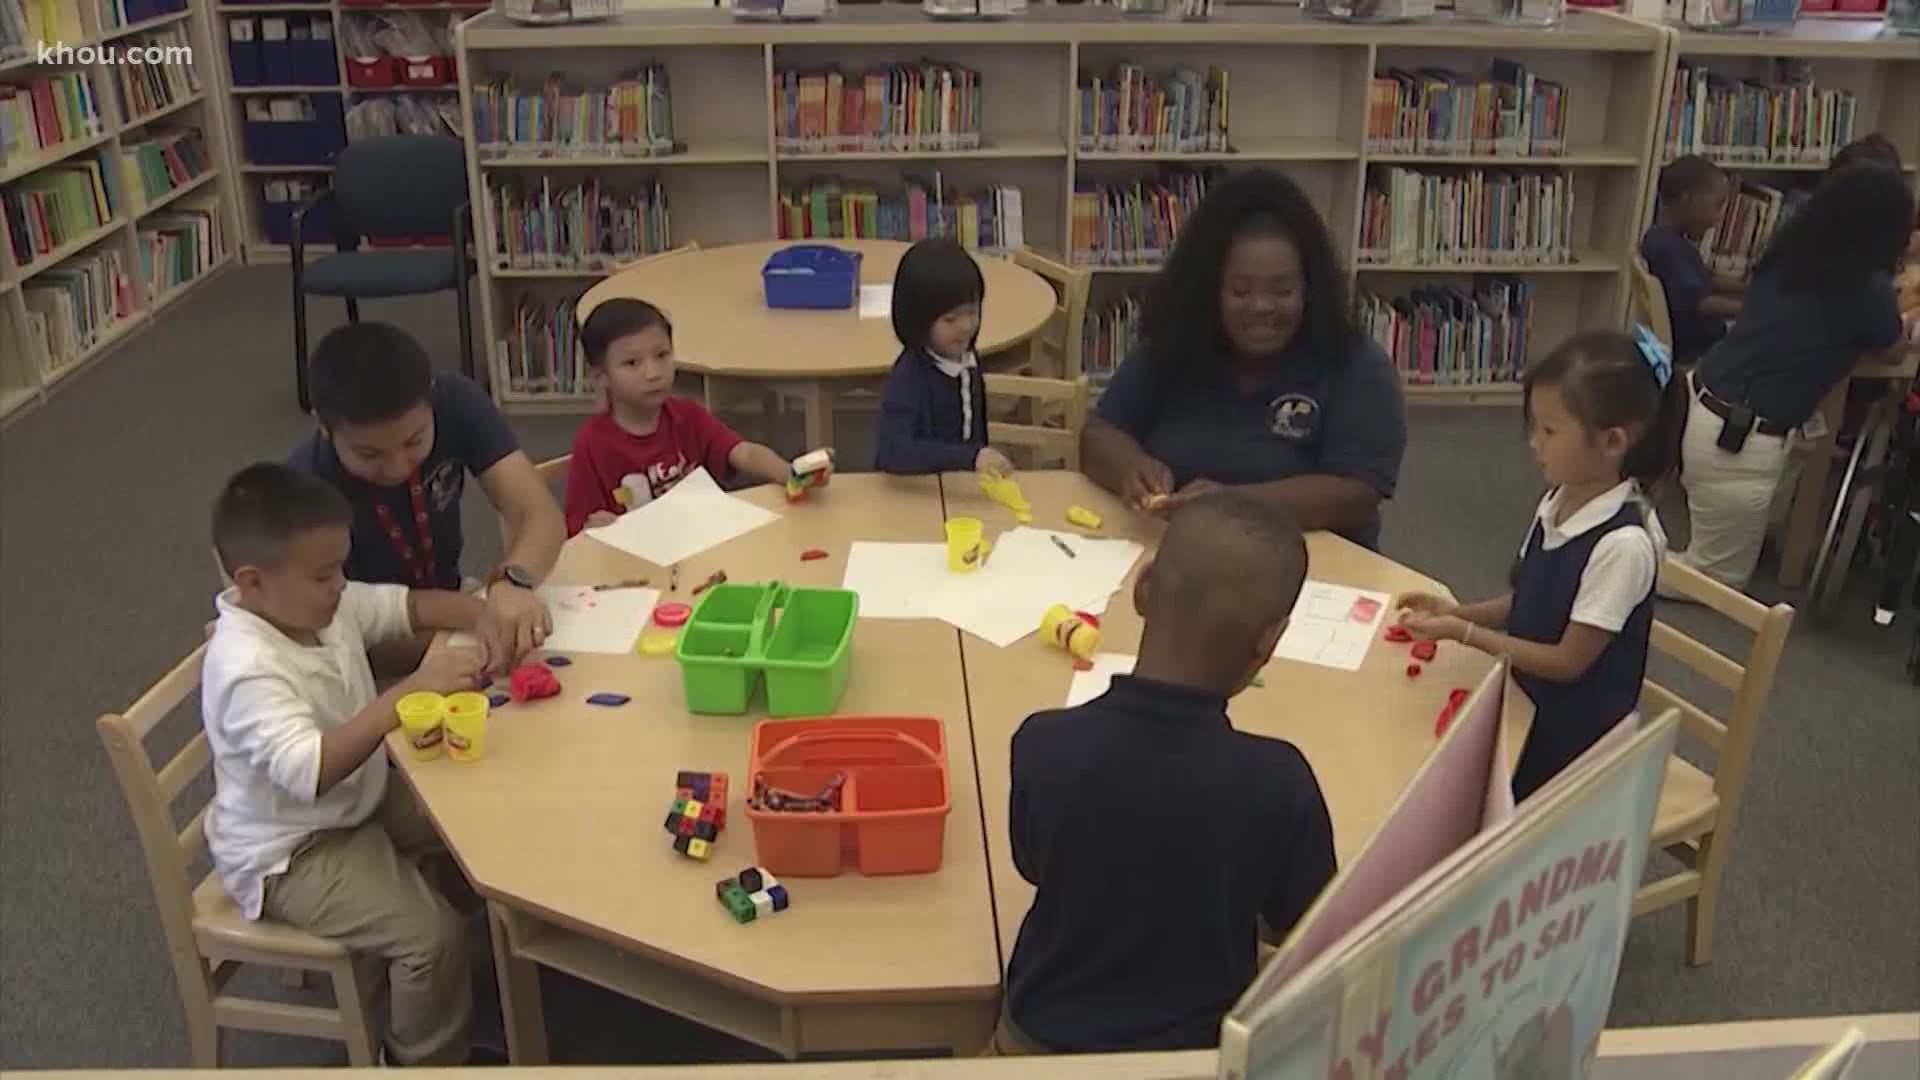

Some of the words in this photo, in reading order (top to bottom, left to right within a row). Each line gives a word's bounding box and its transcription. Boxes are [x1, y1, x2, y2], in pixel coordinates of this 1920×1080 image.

[1411, 838, 1625, 1013] GRANDMA
[1480, 940, 1526, 998] TO
[1533, 902, 1595, 961] SAY
